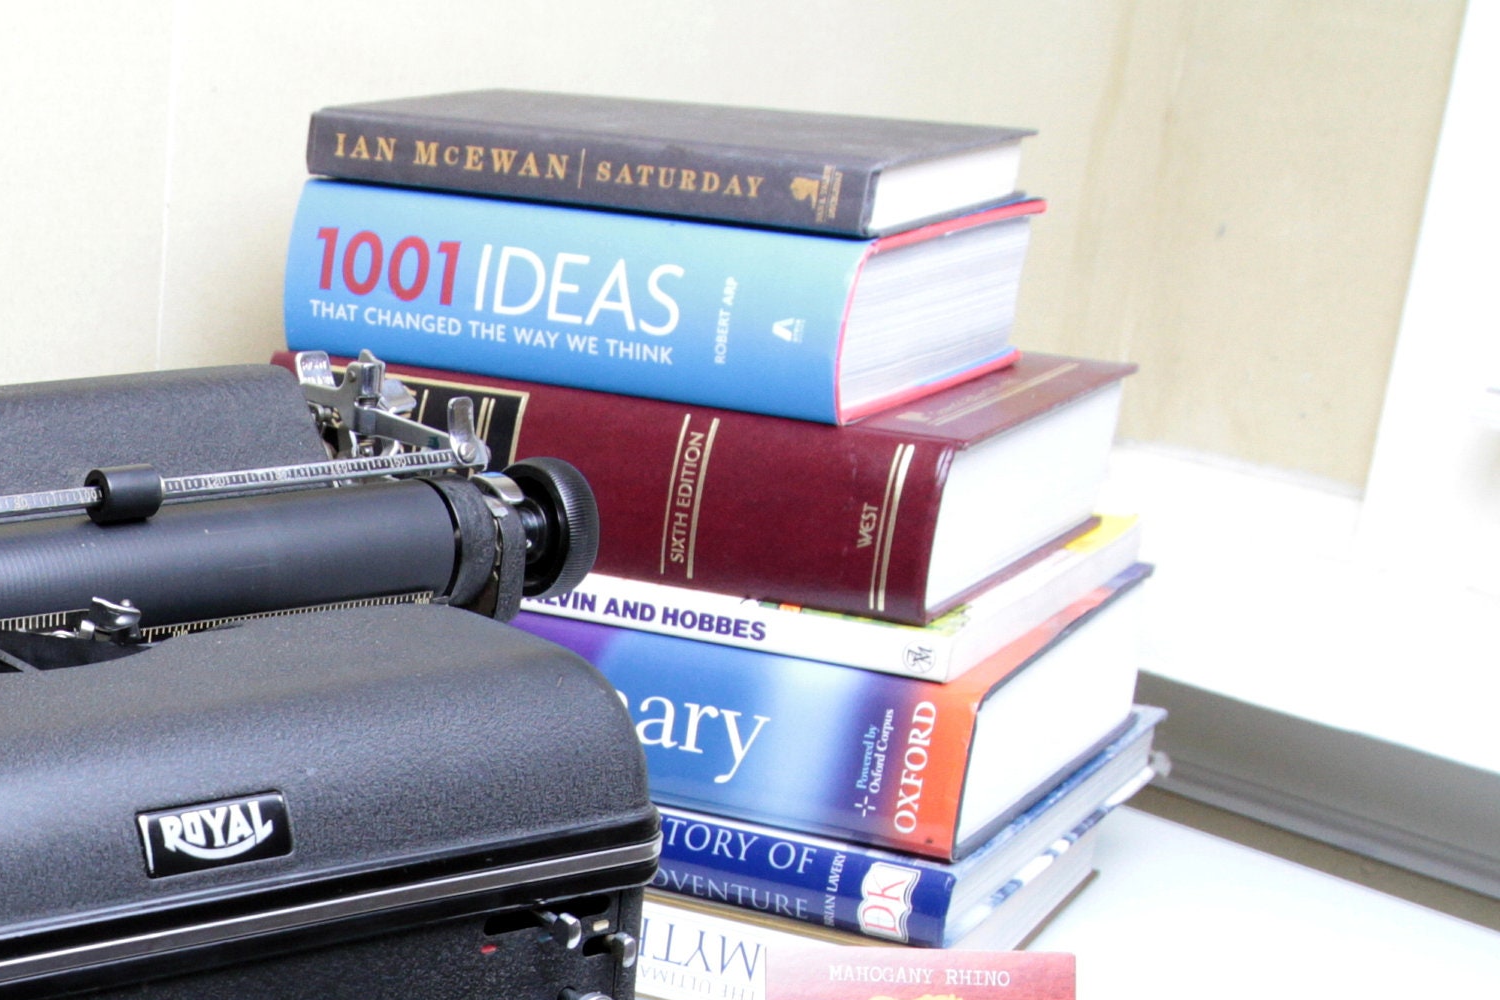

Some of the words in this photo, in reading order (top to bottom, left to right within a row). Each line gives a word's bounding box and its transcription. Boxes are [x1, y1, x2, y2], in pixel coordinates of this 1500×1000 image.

[334, 133, 397, 162] IAN
[595, 160, 765, 197] SATURDAY
[317, 227, 462, 306] 1001
[475, 243, 685, 336] IDEAS
[722, 276, 738, 306] ARP
[309, 299, 359, 322] THAT
[364, 306, 462, 336] CHANGED
[468, 320, 507, 343] THE
[513, 326, 560, 349] WAY
[566, 333, 599, 355] WE
[605, 338, 674, 365] THINK
[714, 308, 731, 364] ROBERT
[676, 431, 705, 509] EDITION
[670, 511, 689, 564] SIXTH
[856, 502, 879, 548] WEST
[526, 591, 597, 613] LVIN
[603, 597, 656, 622] AND
[661, 606, 767, 641] HOBBES
[616, 689, 771, 784] ary
[876, 708, 894, 751] Corpus
[855, 741, 875, 789] Powered
[869, 724, 880, 740] by
[868, 751, 886, 794] Oxford
[894, 701, 937, 834] OXFORD
[159, 801, 273, 860] ROYAL
[660, 815, 759, 862] TORY
[768, 841, 817, 874] OF
[826, 852, 847, 893] LAVERY
[824, 894, 836, 927] BRIAN
[862, 874, 907, 934] DK
[829, 965, 934, 985] MAHOGANY
[945, 968, 1011, 987] RHINO
